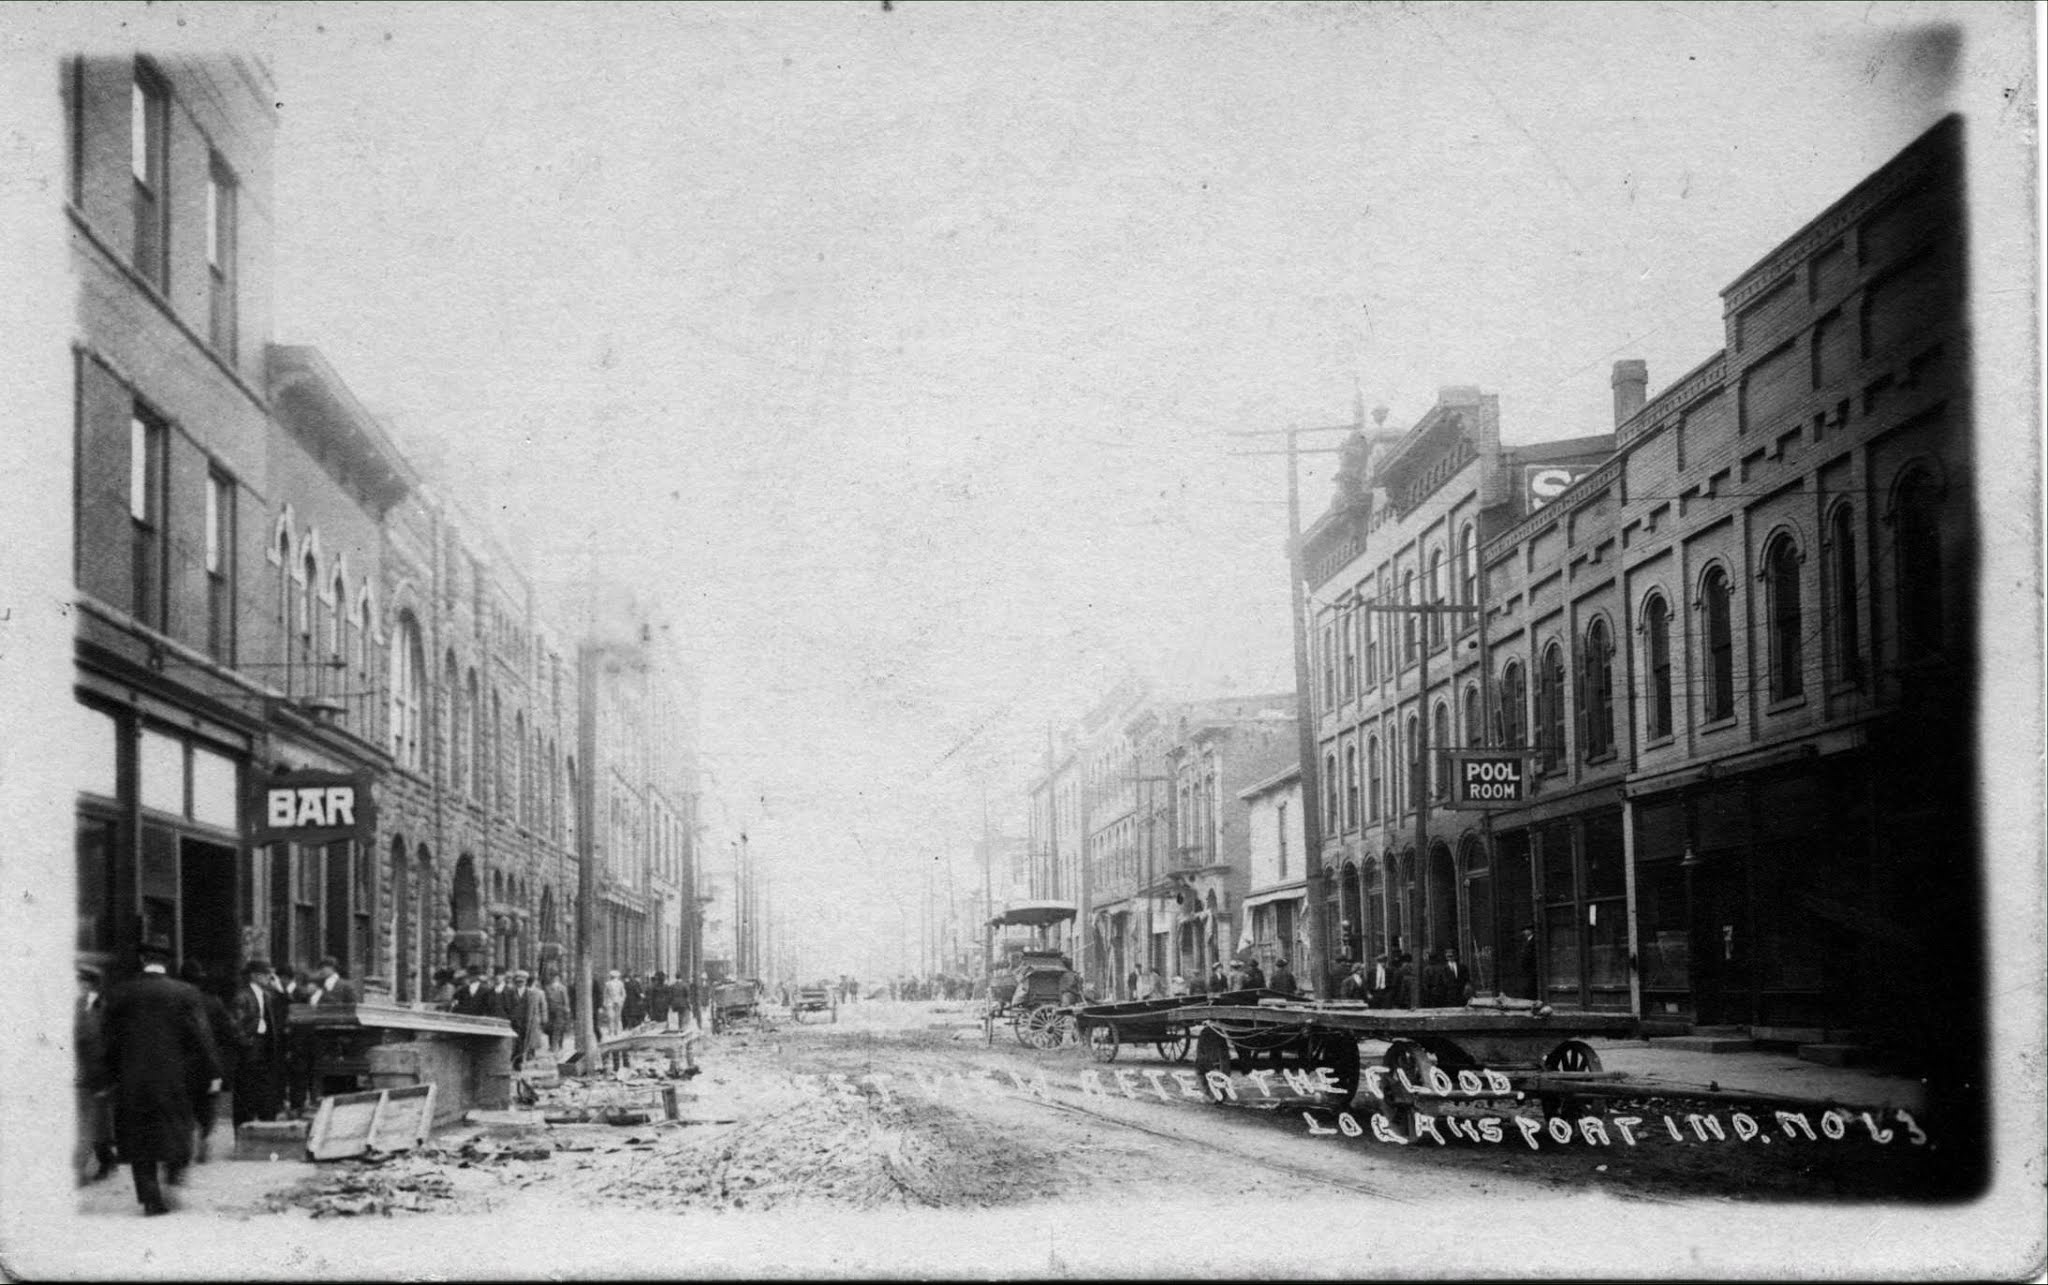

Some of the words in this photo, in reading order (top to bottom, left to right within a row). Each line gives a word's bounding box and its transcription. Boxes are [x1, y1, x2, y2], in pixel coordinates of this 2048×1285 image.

[1467, 762, 1520, 781] POOL
[1470, 783, 1515, 798] ROOM
[267, 786, 355, 828] BAR
